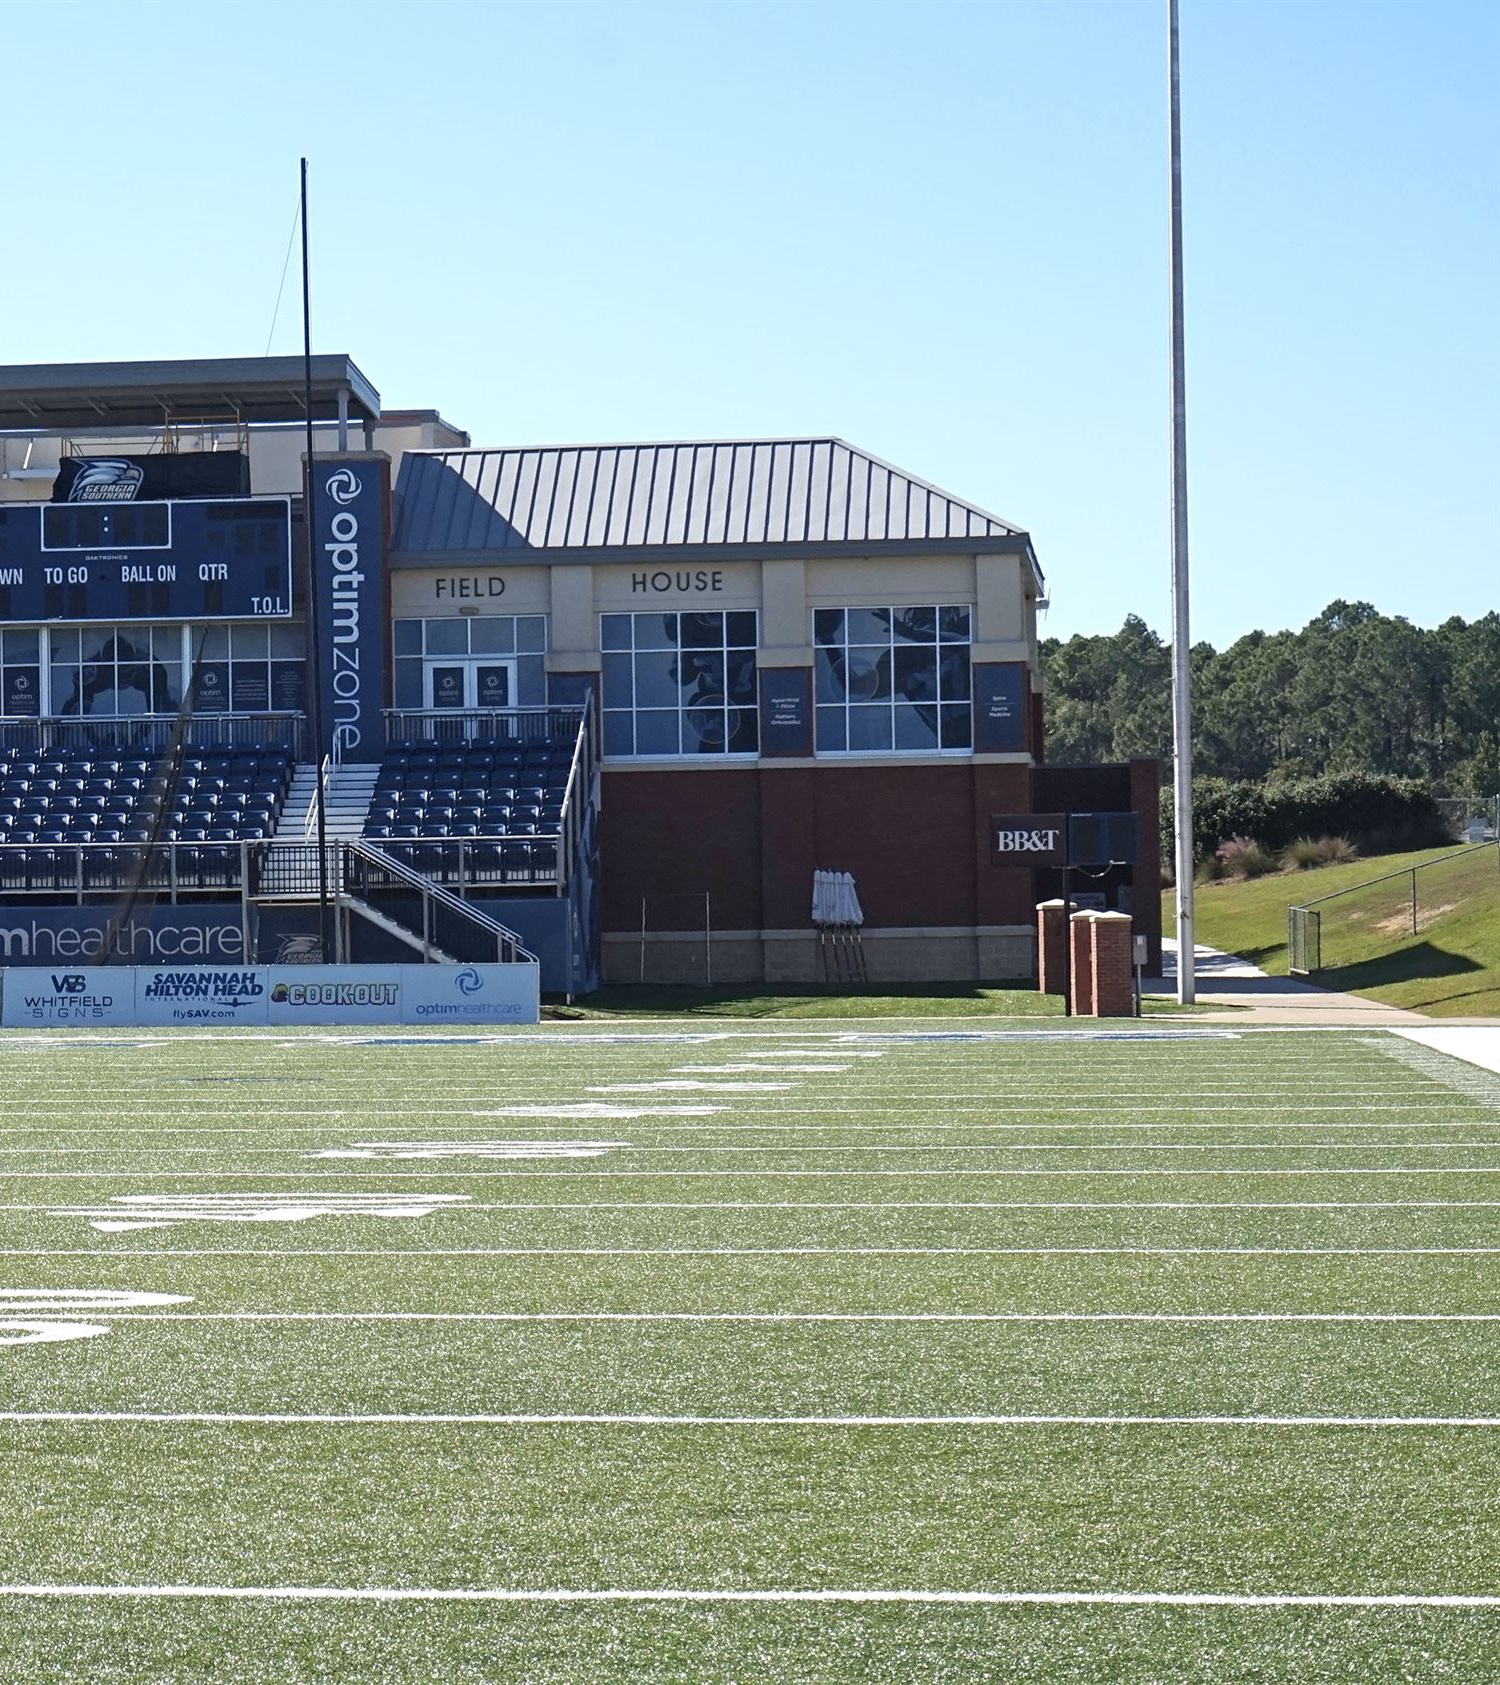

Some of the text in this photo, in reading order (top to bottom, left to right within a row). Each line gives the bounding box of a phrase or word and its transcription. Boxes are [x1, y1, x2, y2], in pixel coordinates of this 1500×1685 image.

[85, 484, 136, 492] GEORGIA
[81, 492, 132, 500] SOUTHERN
[44, 566, 88, 584] TO GO
[121, 564, 176, 582] BALL ON
[199, 563, 228, 581] QTR
[435, 577, 506, 598] FIELD
[632, 571, 723, 592] HOUSE
[251, 597, 288, 613] T.O.L.
[325, 512, 364, 749] optimzone
[997, 830, 1060, 851] BB&T
[153, 972, 256, 985] SAVANNAH
[145, 984, 263, 996] HILTON HEAD
[25, 996, 113, 1007] WHITFIELD
[416, 1002, 522, 1016] optimhealthcare
[173, 1009, 235, 1019] flySAV.com
